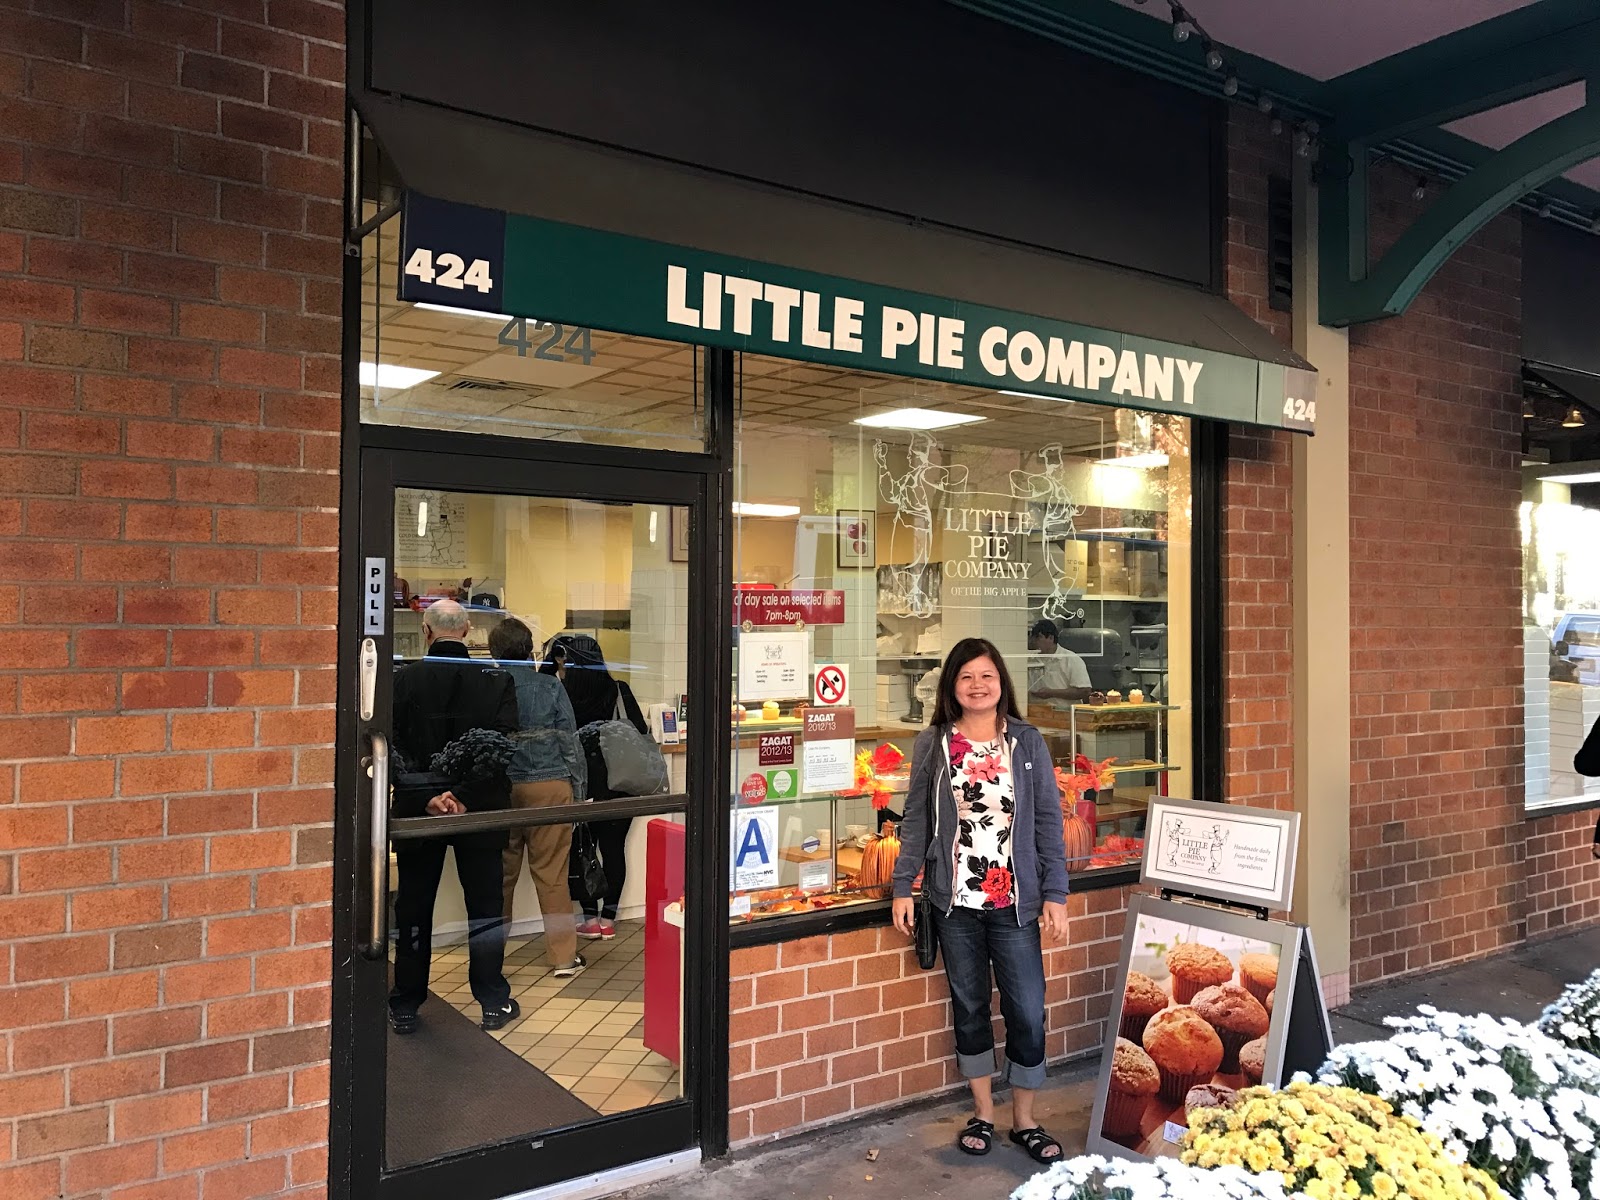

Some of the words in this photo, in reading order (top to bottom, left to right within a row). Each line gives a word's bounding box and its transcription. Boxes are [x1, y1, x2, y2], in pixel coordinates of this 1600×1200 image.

[405, 248, 492, 293] 424
[667, 264, 864, 354] LITTLE
[881, 306, 965, 370] PIE
[979, 326, 1204, 404] COMPANY
[498, 316, 597, 366] 424
[1283, 397, 1316, 422] 424
[944, 508, 1032, 536] LITTLE
[968, 535, 1009, 561] PIE
[945, 560, 1032, 580] COMPANY
[370, 568, 380, 626] PULL
[951, 587, 962, 596] OF
[962, 587, 981, 596] THE
[983, 587, 998, 596] BIG
[1000, 587, 1026, 596] APPLE
[734, 593, 743, 605] of
[745, 593, 760, 608] day
[762, 593, 778, 605] sale
[780, 595, 790, 605] on
[791, 593, 822, 605] selected
[823, 593, 841, 605] items
[766, 610, 801, 622] 7pm-8pm
[808, 713, 835, 723] ZAGAT
[808, 722, 836, 732] 2012/13
[761, 736, 792, 746] ZAGAT
[761, 746, 792, 756] 2012/13
[736, 818, 770, 867] A
[1182, 838, 1208, 850] LITTLE
[1234, 844, 1259, 852] Handmade
[1181, 853, 1206, 861] COMPANY
[1188, 847, 1201, 855] PIE
[1237, 863, 1263, 871] ingredients
